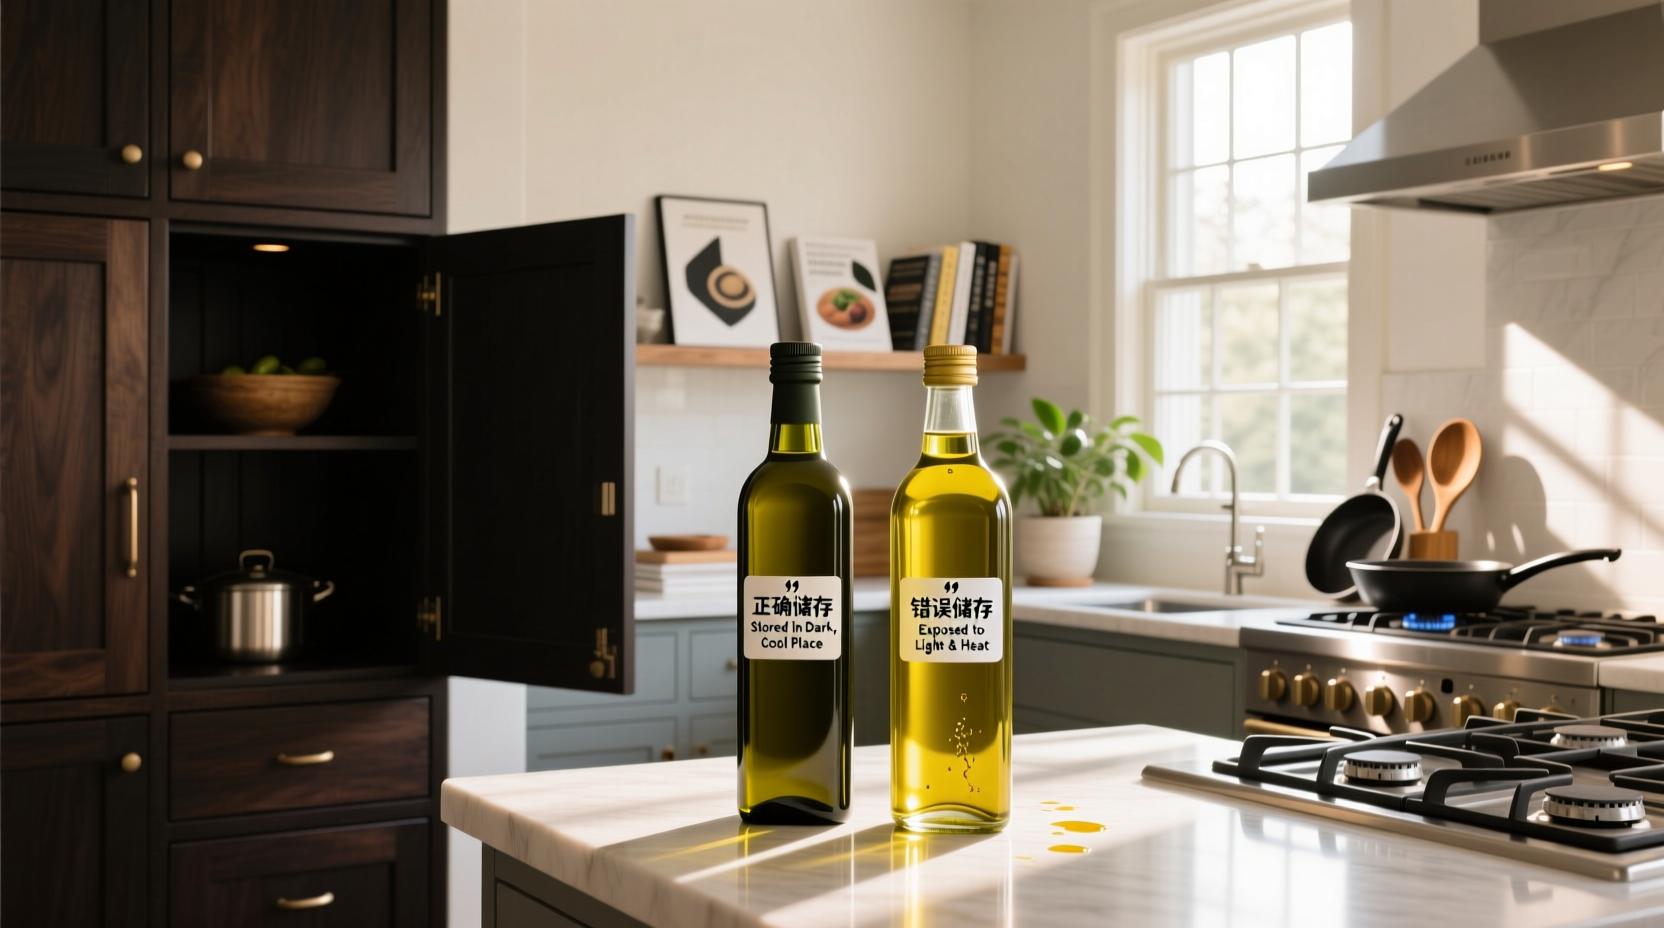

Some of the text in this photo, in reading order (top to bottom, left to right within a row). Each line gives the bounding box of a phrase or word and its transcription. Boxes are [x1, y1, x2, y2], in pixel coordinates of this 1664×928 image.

[752, 595, 833, 617] 正确储存
[910, 597, 993, 619] 错误储存
[806, 621, 837, 635] Dark,
[973, 624, 985, 635] to
[761, 637, 823, 649] Cool Place
[916, 638, 990, 655] Light & Heat
